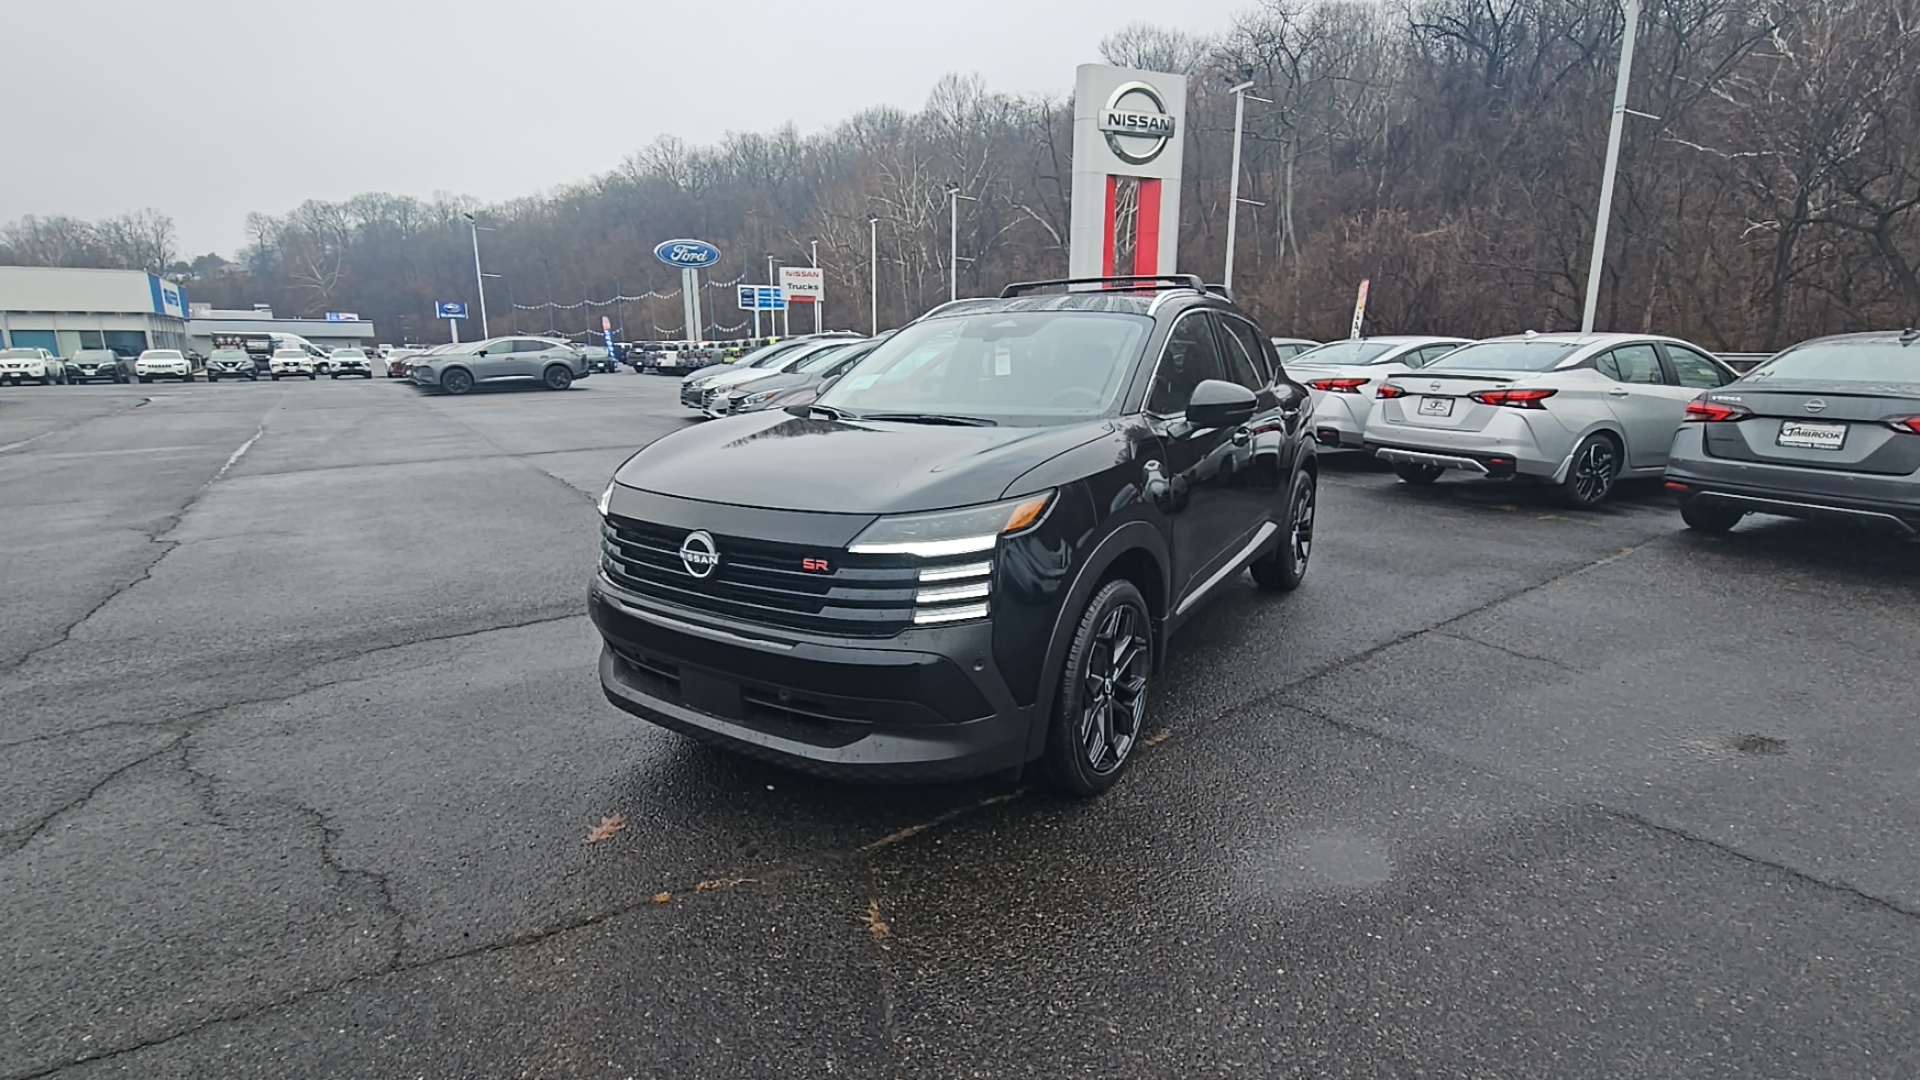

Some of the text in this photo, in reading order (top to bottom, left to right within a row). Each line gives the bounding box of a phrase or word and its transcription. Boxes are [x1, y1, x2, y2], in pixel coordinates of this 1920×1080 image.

[1107, 113, 1170, 131] NISSAN
[670, 244, 708, 262] Ford
[785, 270, 819, 278] NISSAN
[787, 283, 819, 291] Trucks
[680, 551, 719, 565] NISSAN
[802, 558, 829, 571] SR
